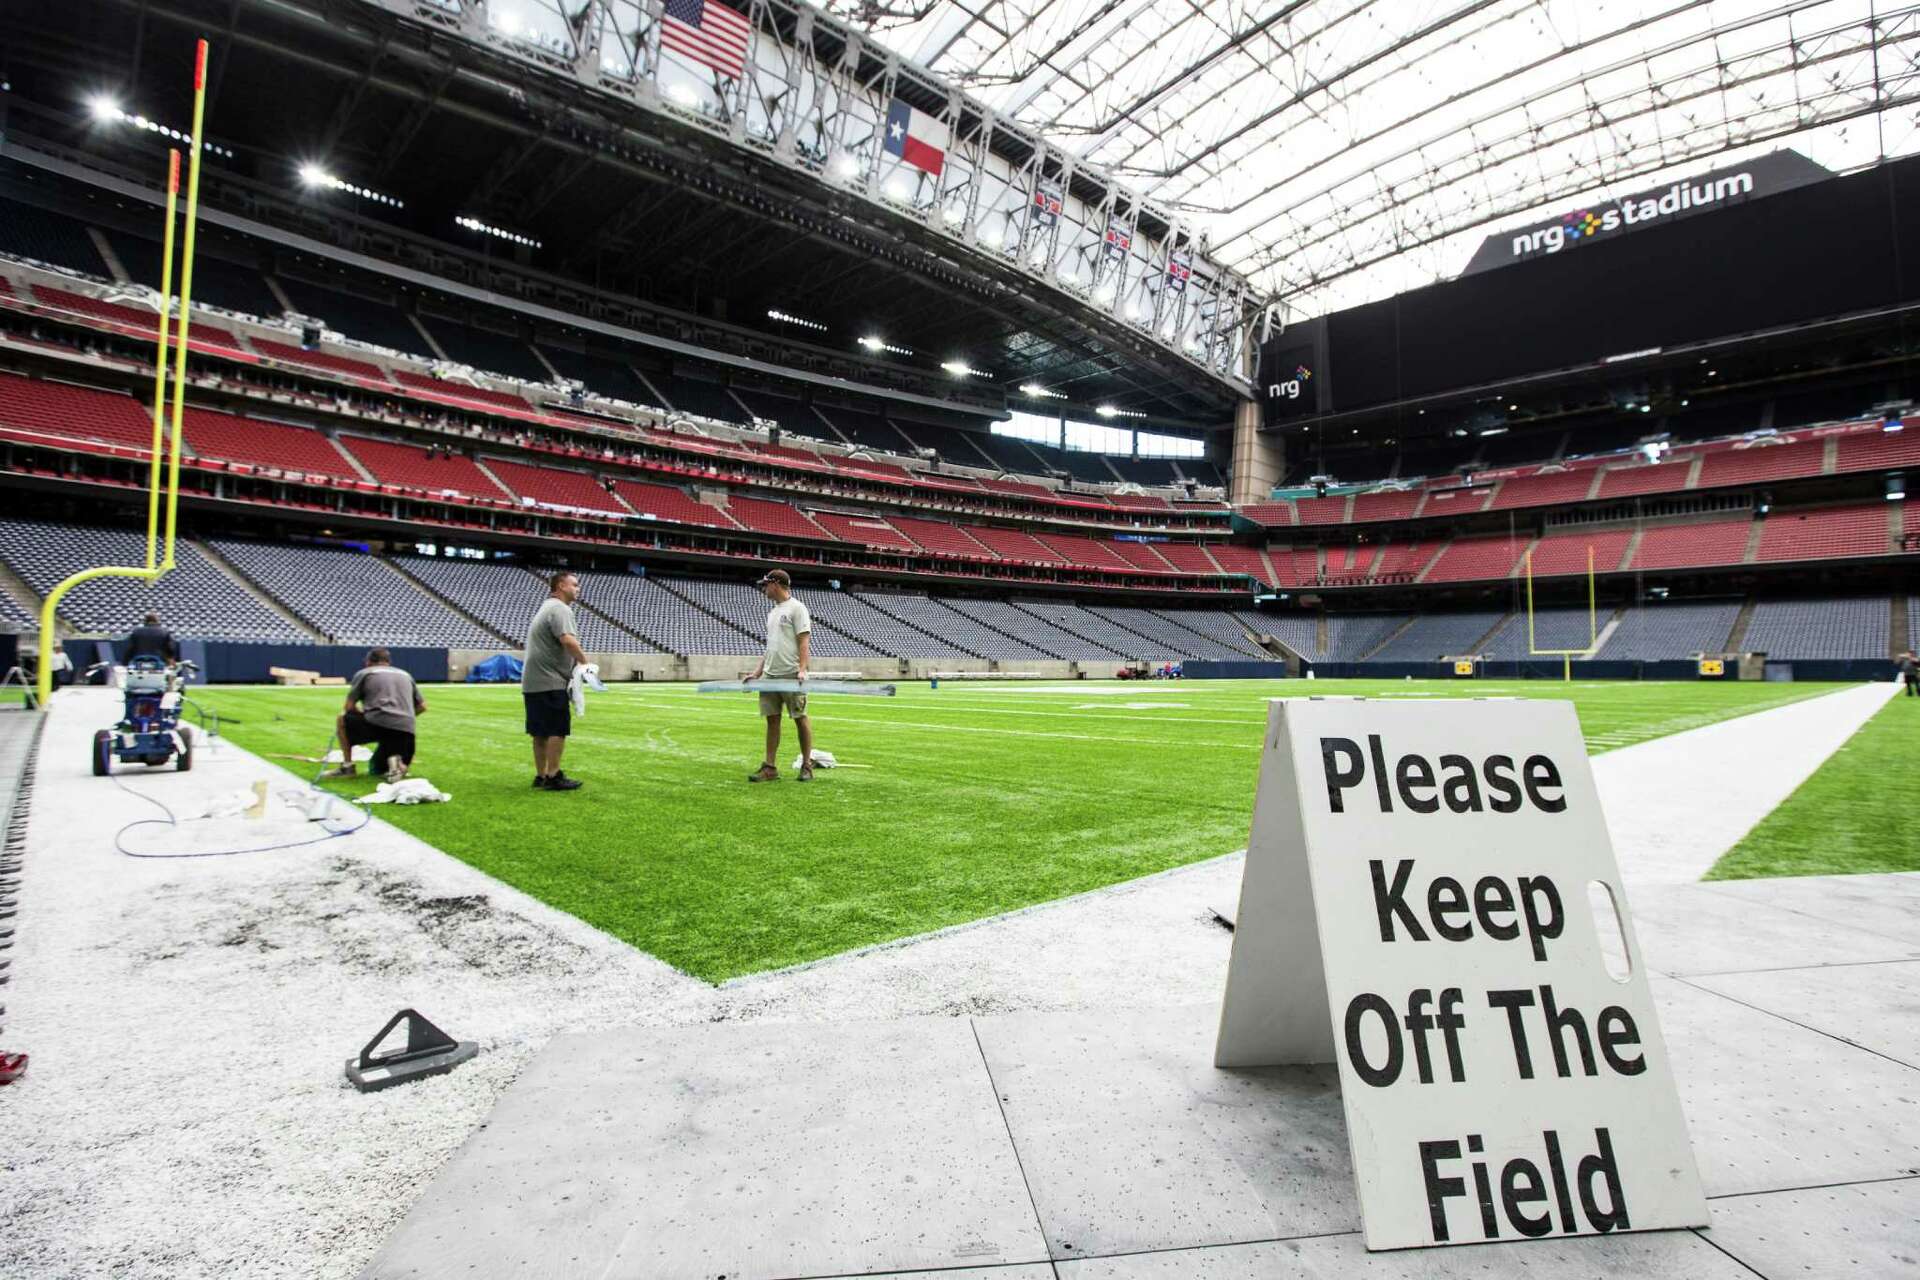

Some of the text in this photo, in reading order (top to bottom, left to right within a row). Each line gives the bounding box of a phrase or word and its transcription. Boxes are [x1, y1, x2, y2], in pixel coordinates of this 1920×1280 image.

[1513, 172, 1753, 255] nrg stadium
[1269, 380, 1300, 399] nrg
[1319, 734, 1568, 814] Please
[1368, 858, 1565, 962] Keep
[1344, 984, 1648, 1088] Off The
[1417, 1127, 1631, 1242] Field
